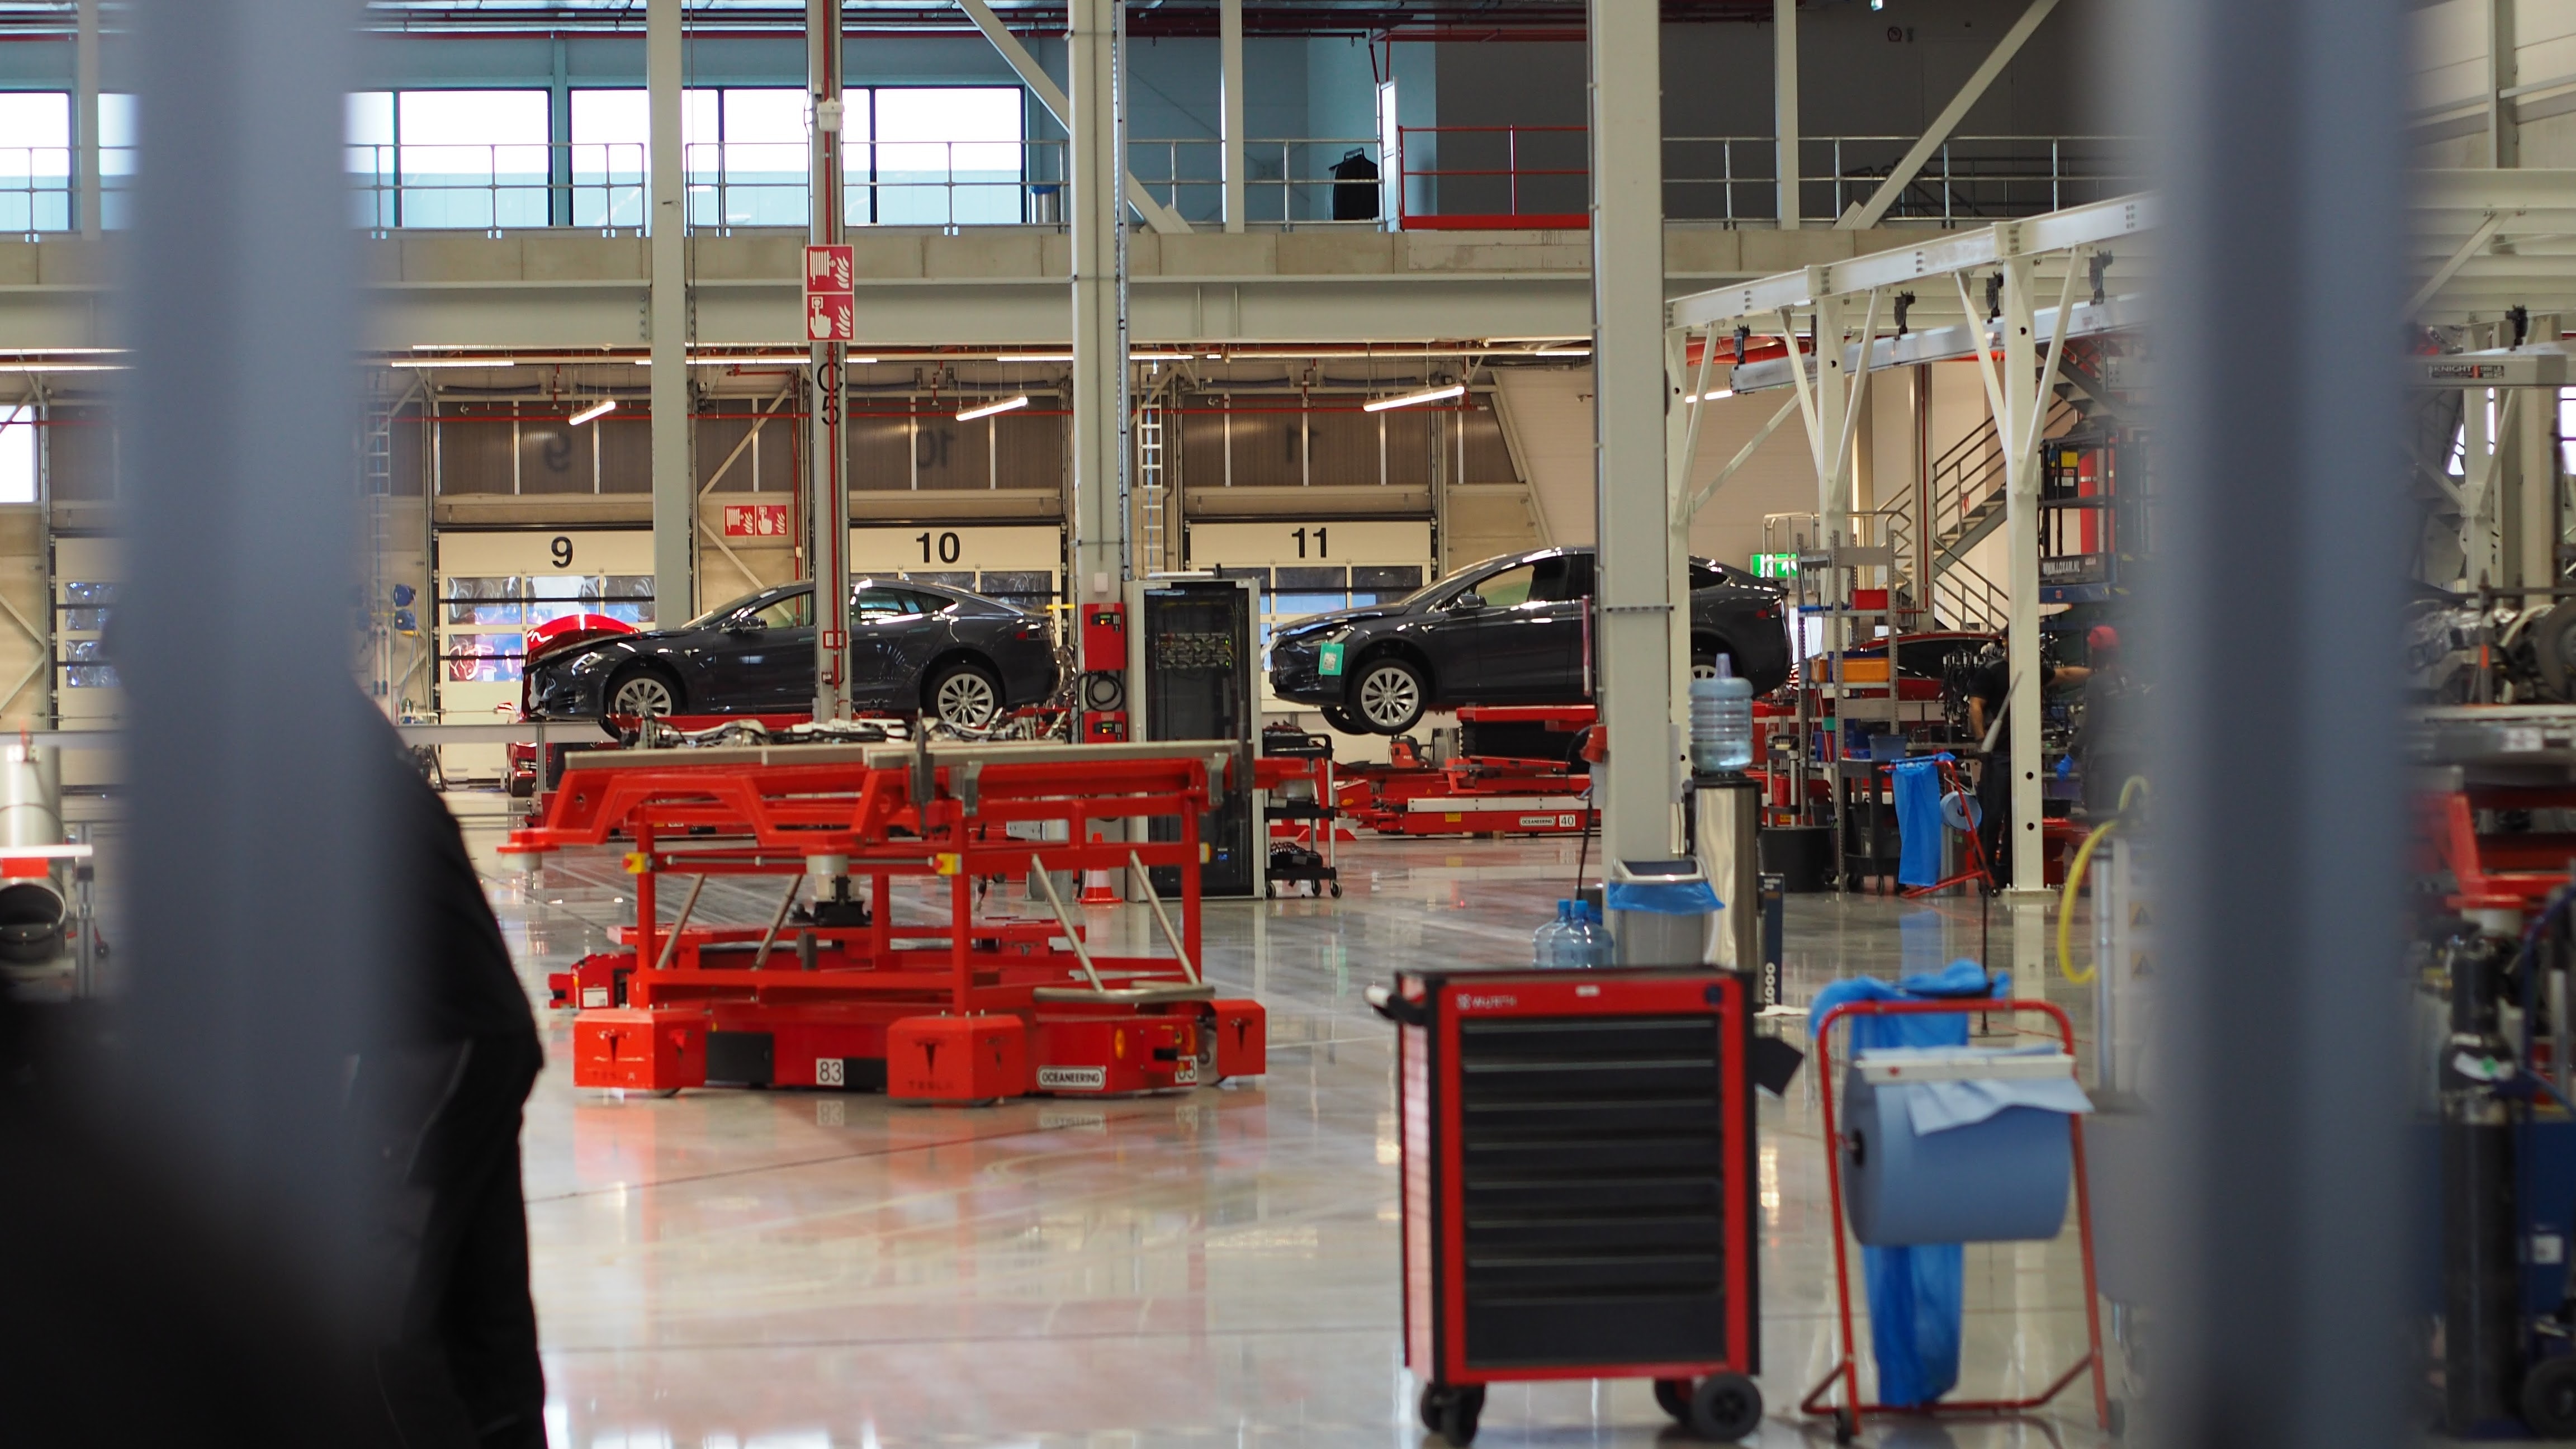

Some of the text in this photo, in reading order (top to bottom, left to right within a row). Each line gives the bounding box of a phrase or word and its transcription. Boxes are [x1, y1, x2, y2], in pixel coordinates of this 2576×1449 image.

[551, 536, 573, 568] 9
[915, 532, 960, 564] 10
[1291, 527, 1327, 558] 11
[1561, 816, 1574, 826] 40
[819, 1061, 842, 1082] 83
[1041, 1072, 1100, 1083] OCEANEERING
